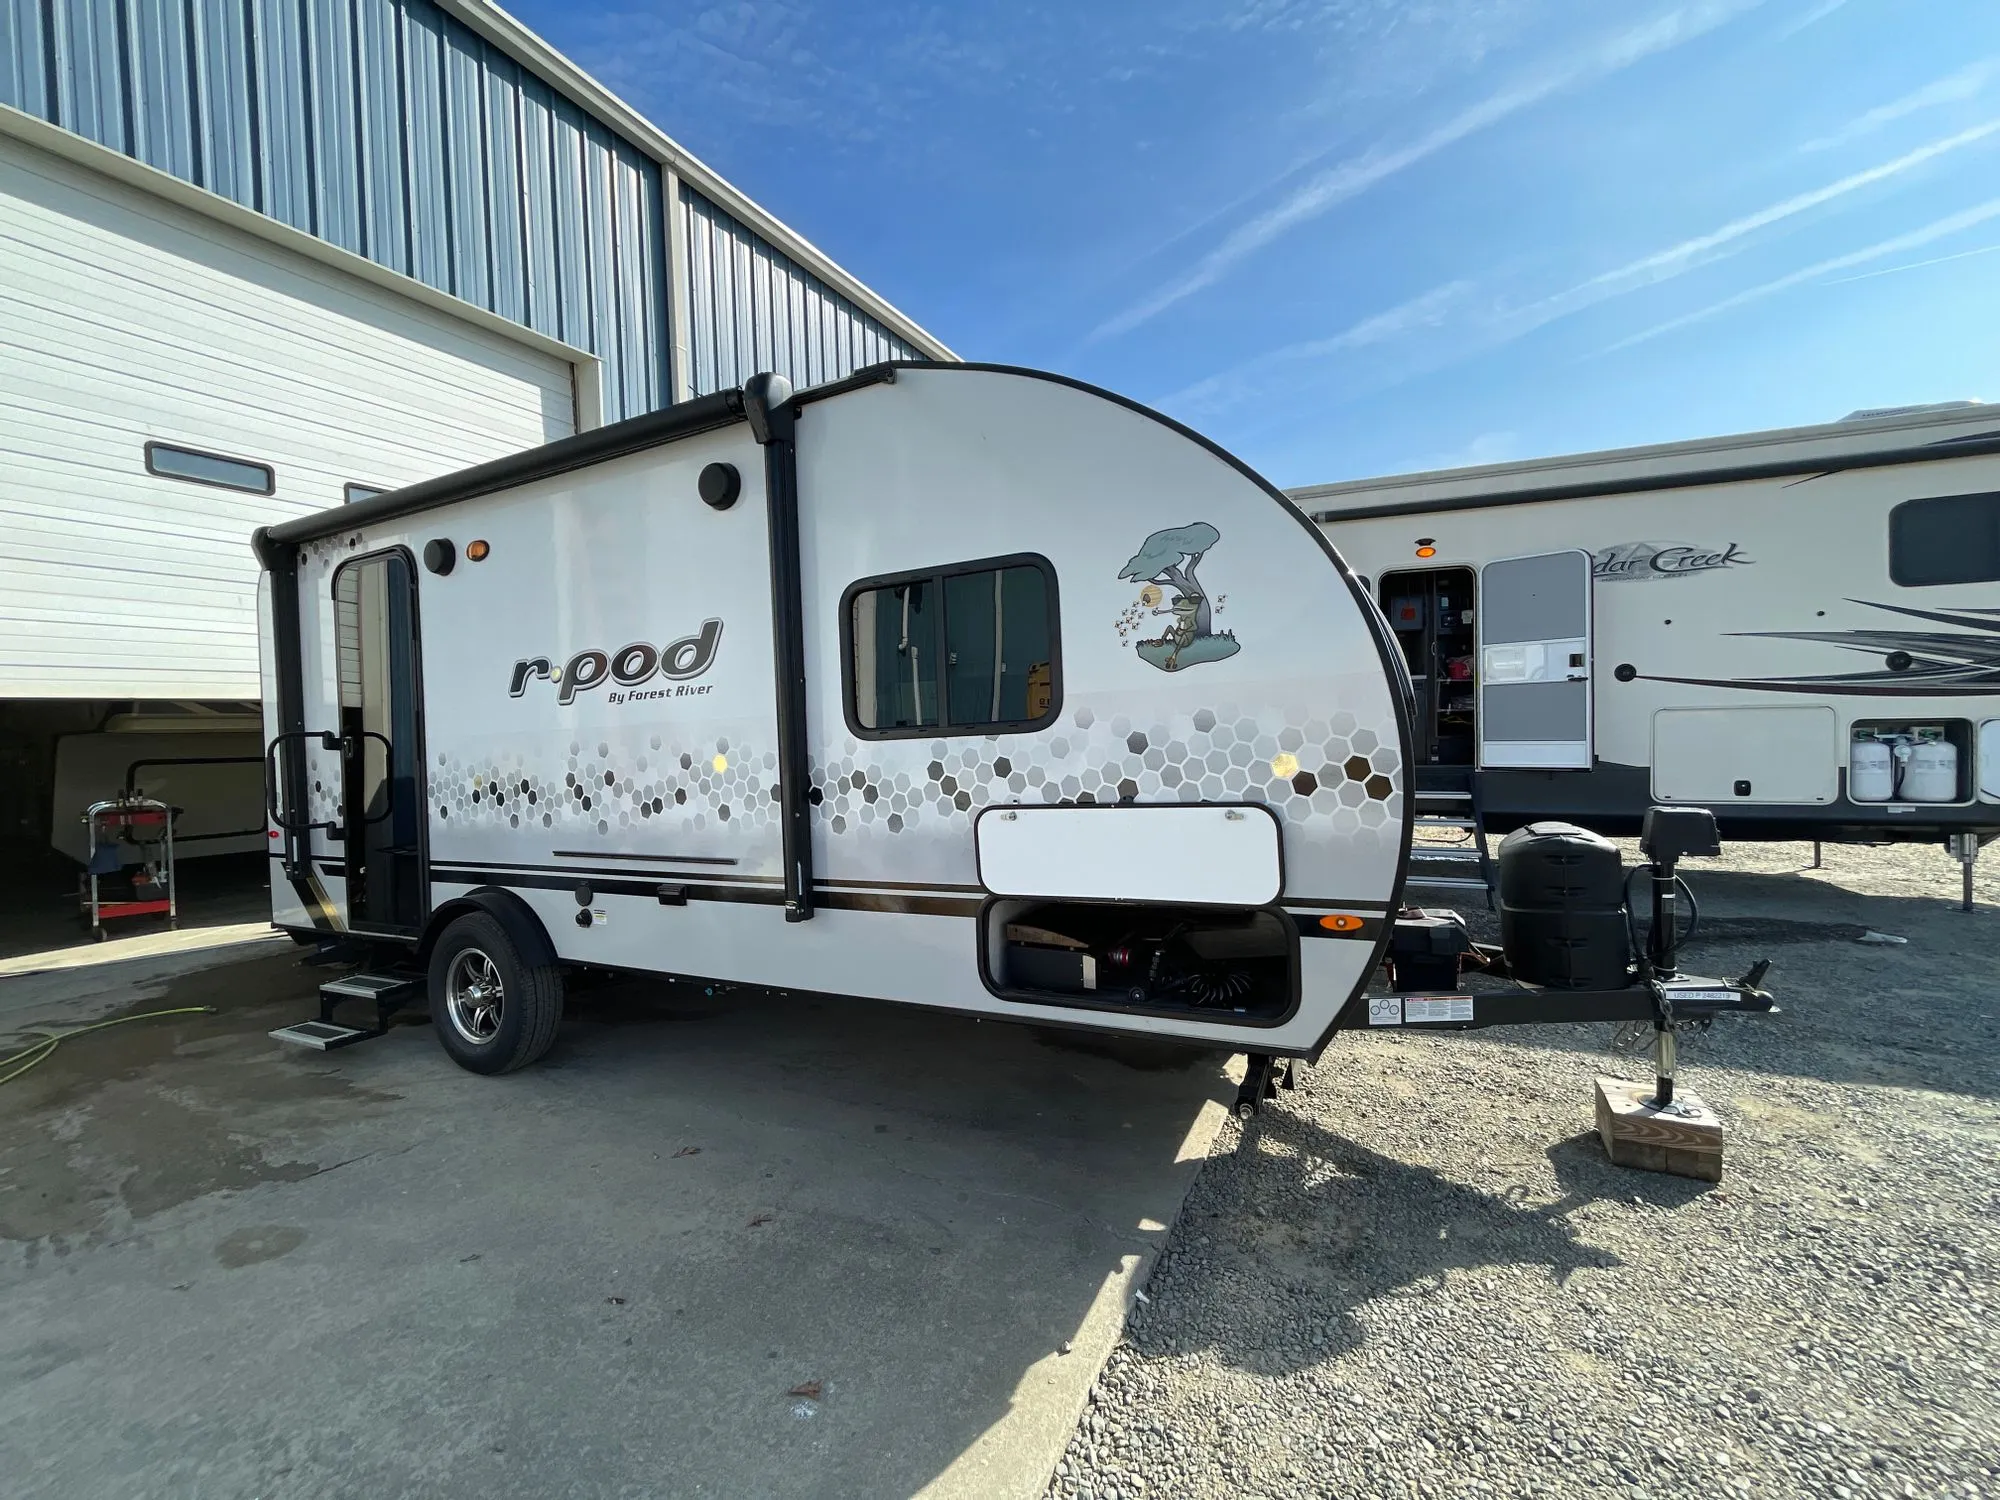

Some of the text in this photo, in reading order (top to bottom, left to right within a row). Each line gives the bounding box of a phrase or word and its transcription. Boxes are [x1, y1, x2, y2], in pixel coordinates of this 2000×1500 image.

[1592, 543, 1756, 573] dar Creek
[608, 684, 713, 705] By Forest River
